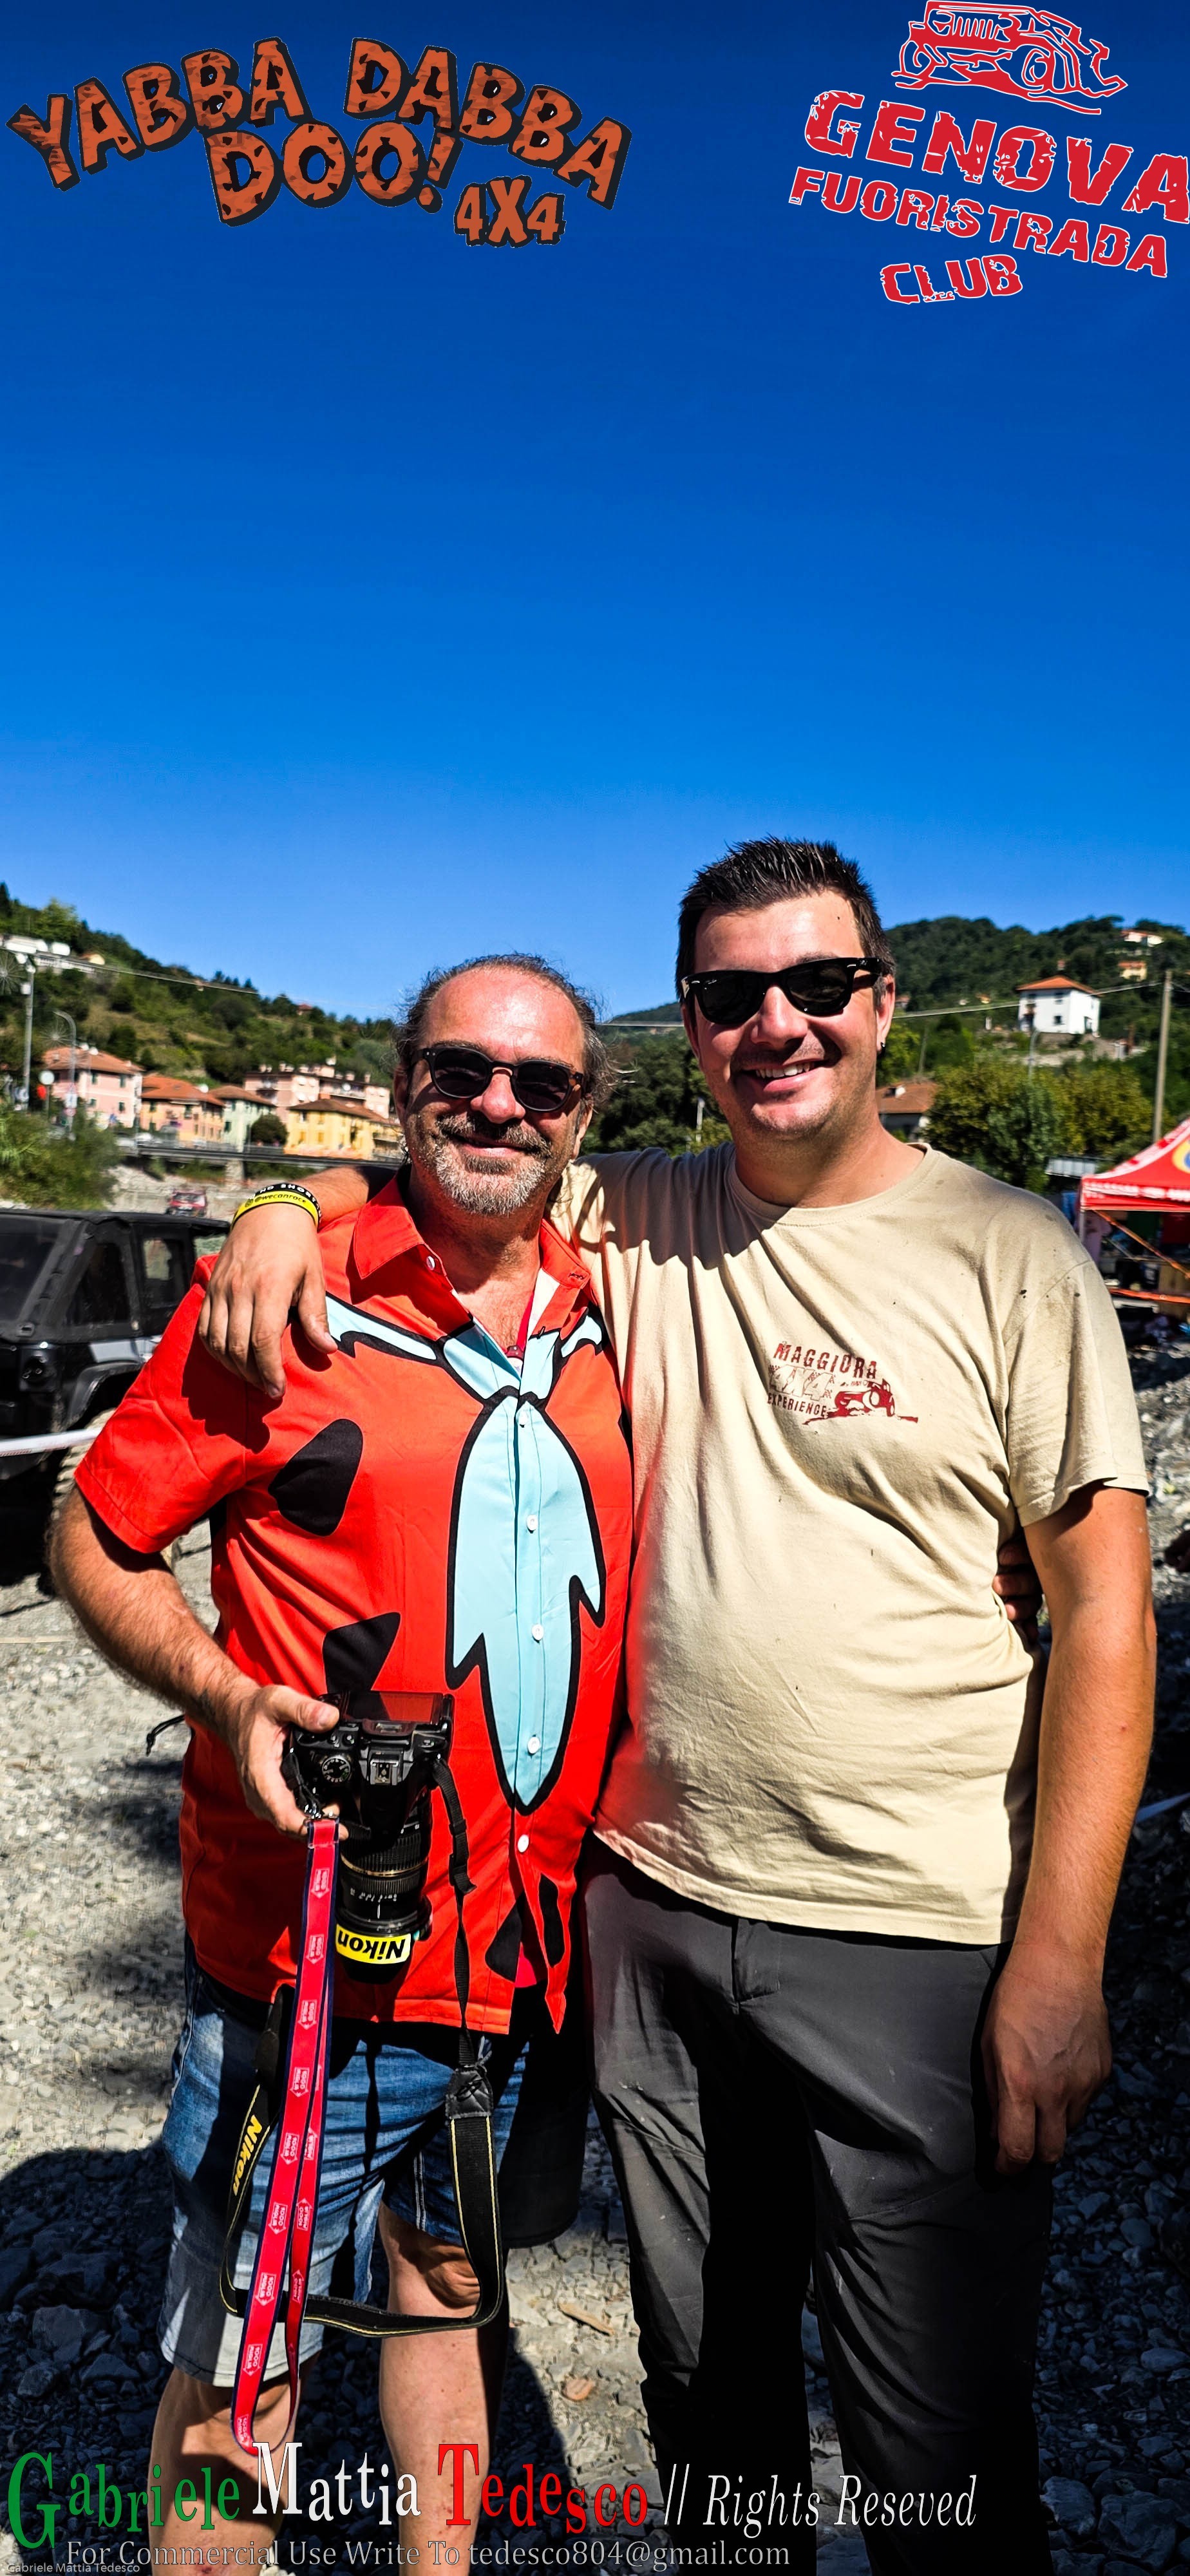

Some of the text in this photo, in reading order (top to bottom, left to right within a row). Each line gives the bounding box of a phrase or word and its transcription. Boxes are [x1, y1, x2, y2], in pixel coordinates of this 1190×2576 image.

[773, 1343, 878, 1379] MAGGIORA
[767, 1392, 827, 1417] EXPERIENCE
[338, 1930, 406, 1960] Nikon
[233, 2114, 262, 2196] Nikon
